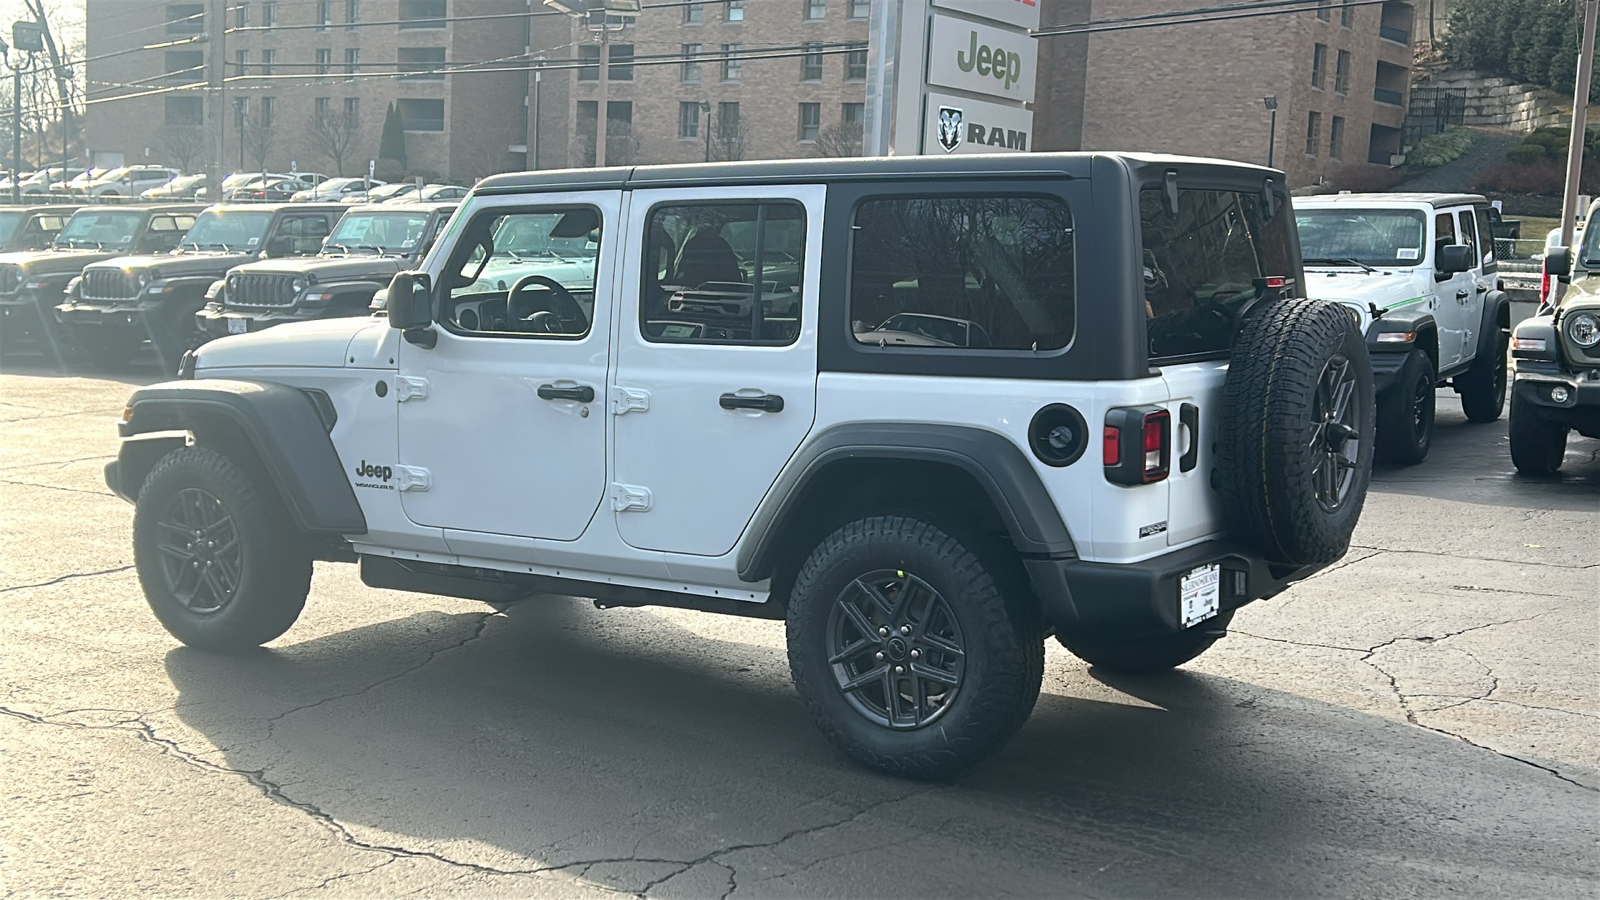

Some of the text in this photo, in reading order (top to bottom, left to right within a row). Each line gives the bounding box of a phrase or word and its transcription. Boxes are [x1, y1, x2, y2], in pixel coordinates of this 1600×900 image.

[957, 30, 1021, 90] Jeep
[967, 123, 1027, 151] RAM
[356, 460, 392, 482] Jeep
[355, 482, 388, 490] WRANGLER
